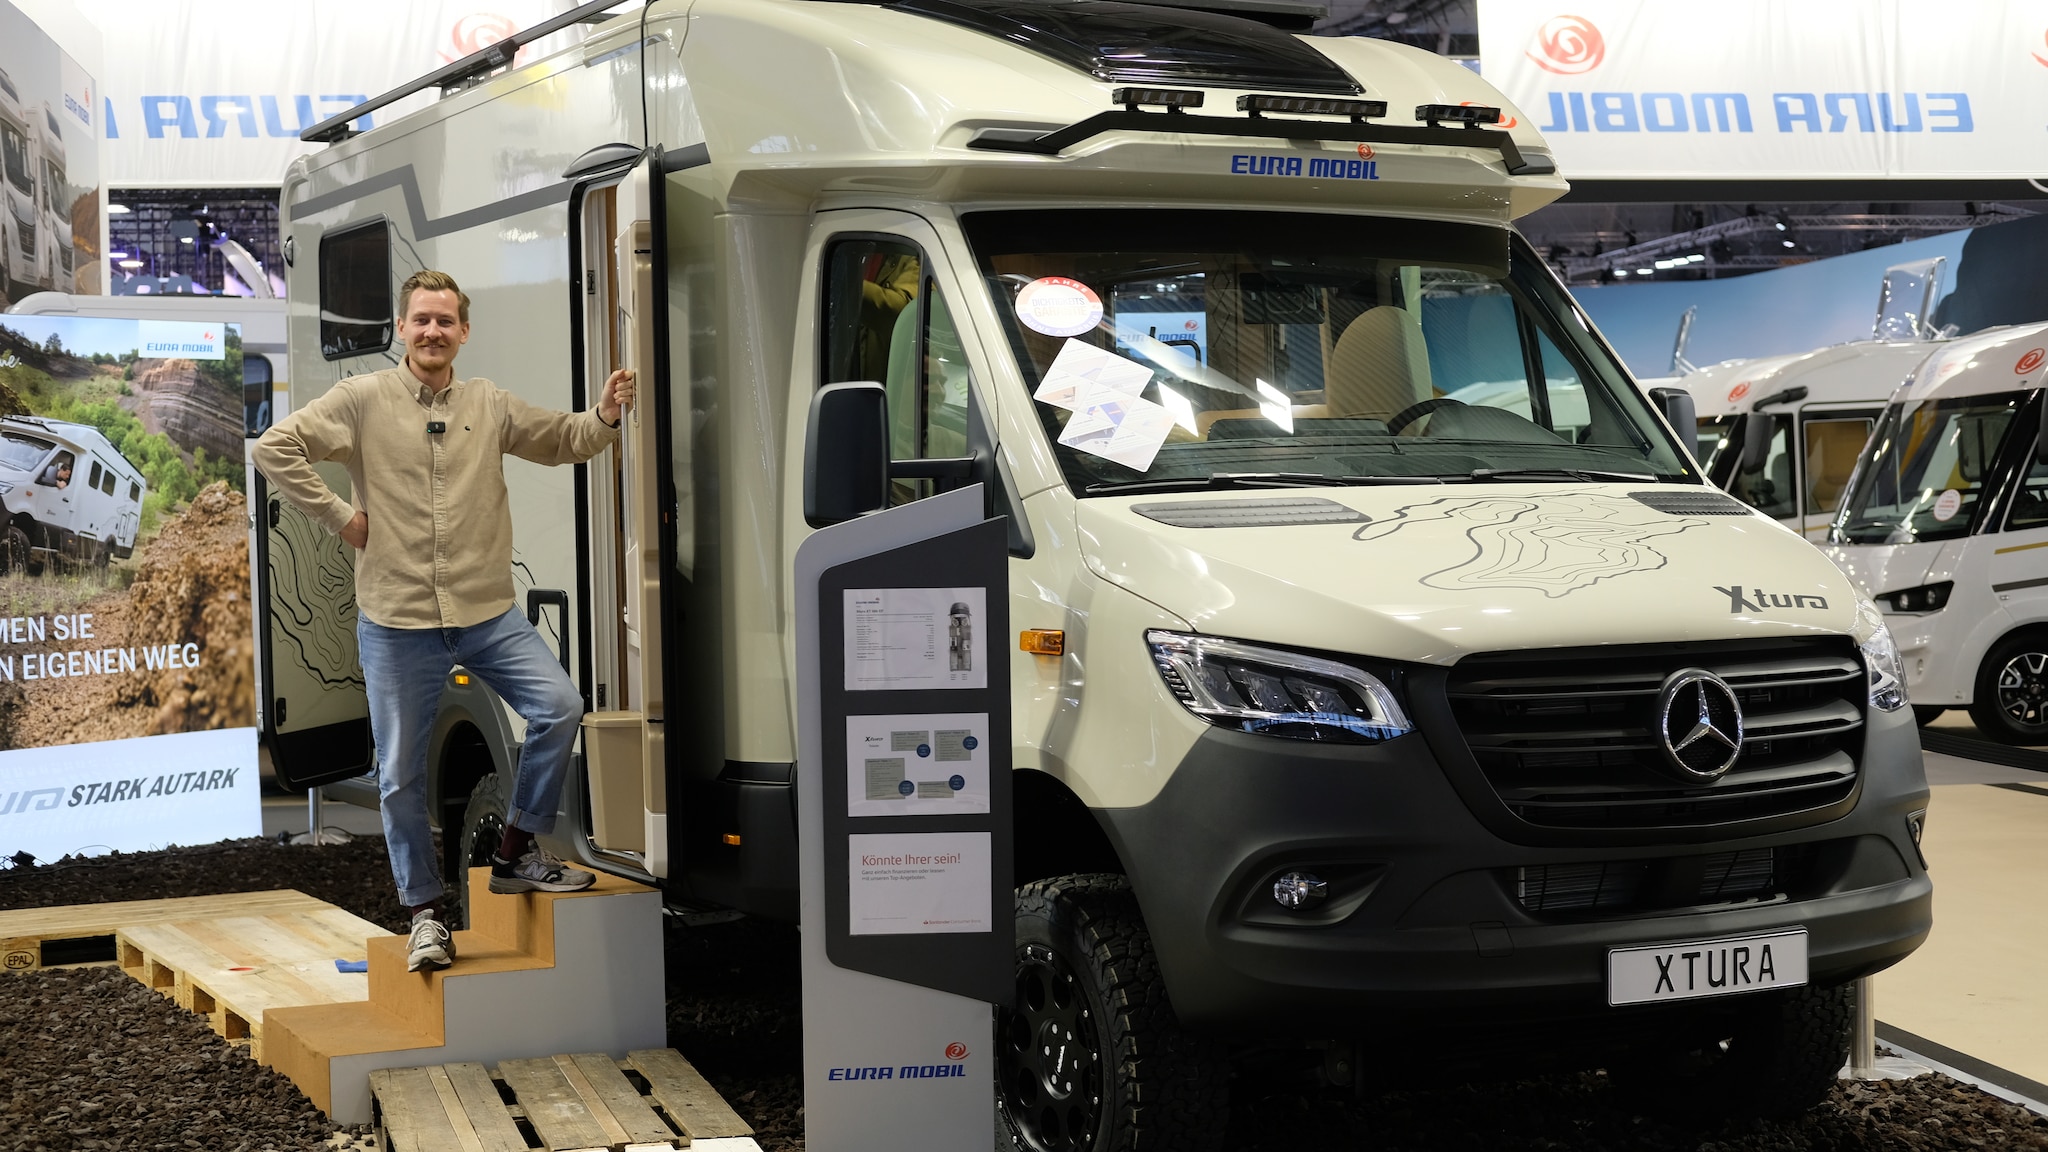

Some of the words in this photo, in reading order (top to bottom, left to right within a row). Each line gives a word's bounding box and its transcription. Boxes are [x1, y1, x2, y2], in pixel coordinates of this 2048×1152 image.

[1231, 155, 1302, 176] EURA
[1309, 158, 1379, 180] MOBIL
[1043, 279, 1088, 293] JAHRE
[147, 343, 179, 352] EURA
[182, 344, 214, 352] MOBIL
[1712, 586, 1829, 613] Xtura
[53, 613, 95, 641] SIE
[22, 647, 136, 680] EIGENEN
[142, 642, 200, 671] WEG
[68, 777, 148, 807] STARK
[146, 768, 240, 798] AUTARK
[862, 854, 902, 866] Könnte
[905, 853, 932, 865] Ihrer
[934, 853, 961, 864] sein!
[8, 955, 30, 966] EPAL
[1655, 944, 1775, 994] XTURA
[828, 1067, 894, 1081] EURA
[900, 1064, 966, 1079] MOBIL
